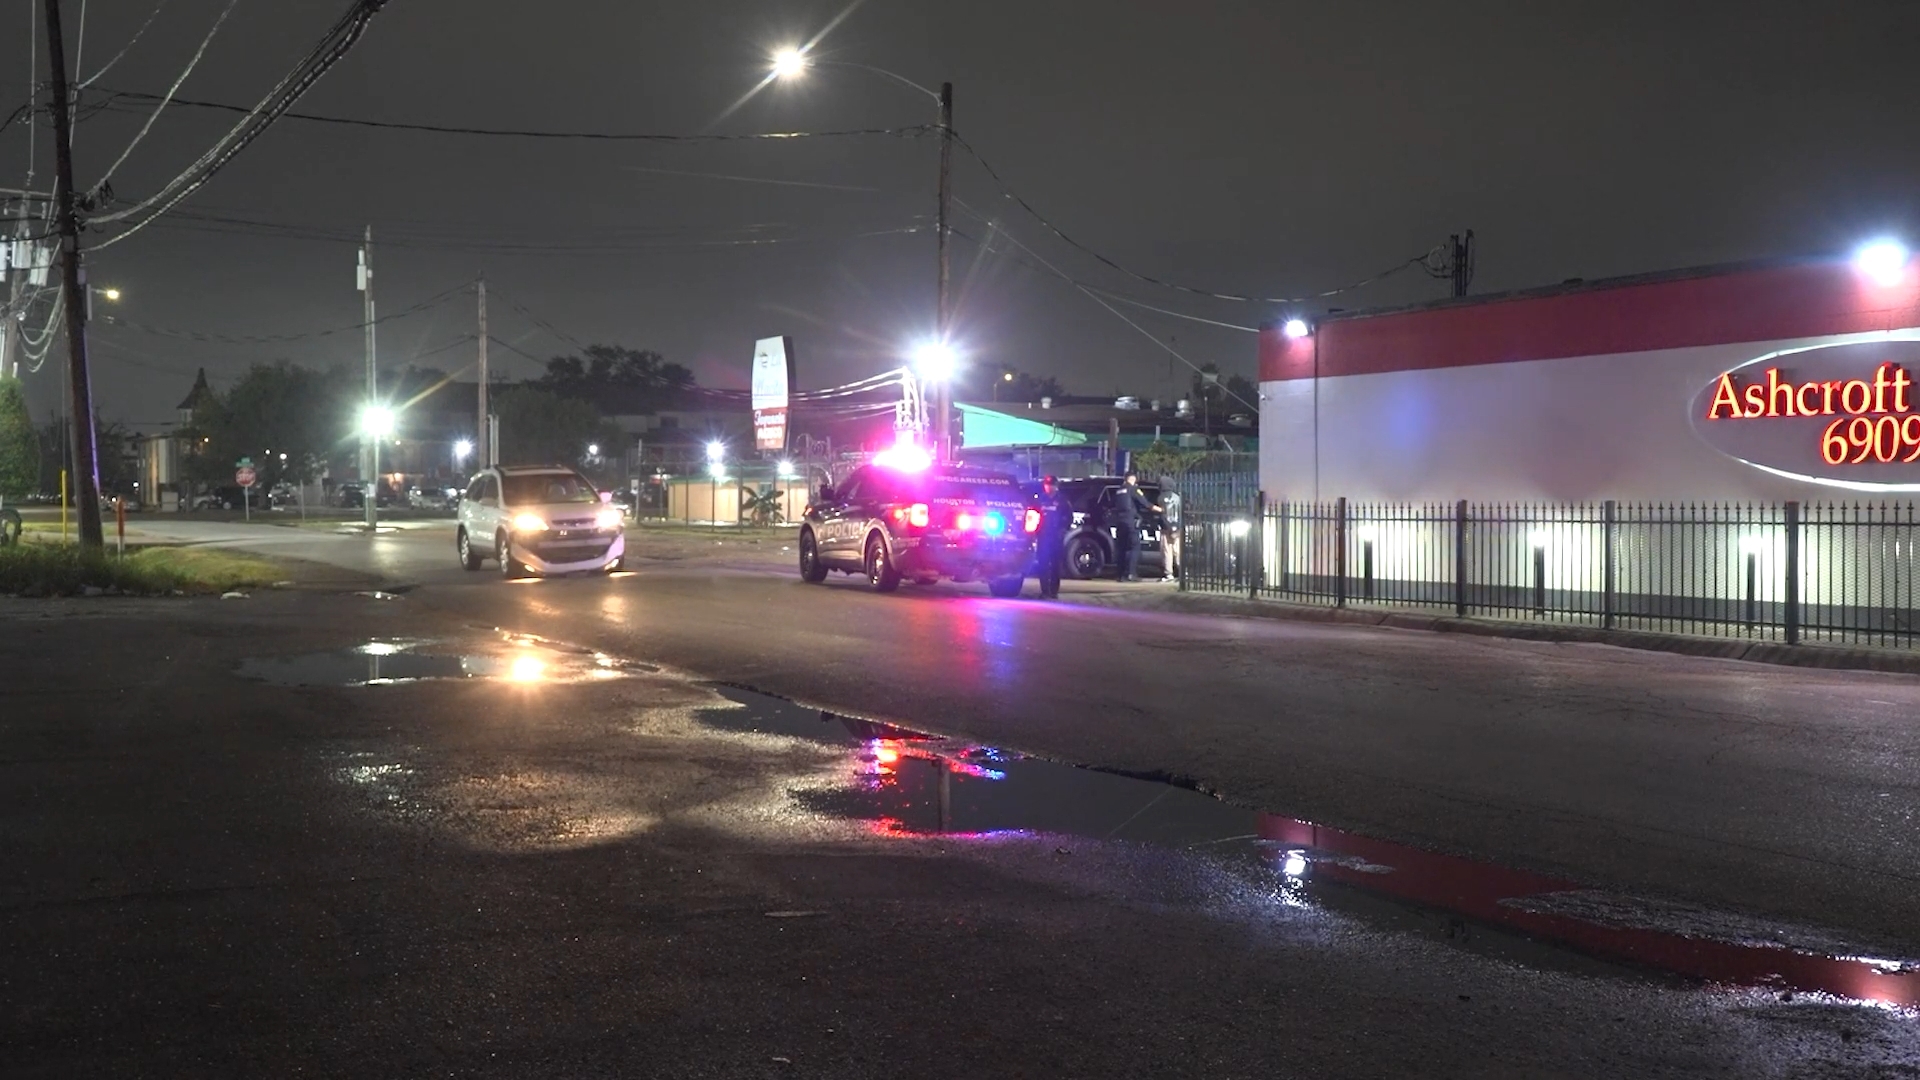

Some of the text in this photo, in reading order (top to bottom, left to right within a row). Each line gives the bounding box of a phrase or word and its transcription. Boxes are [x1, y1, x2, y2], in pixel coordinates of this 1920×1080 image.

[1706, 360, 1911, 420] Ashcroft
[1821, 413, 1920, 466] 6909
[933, 498, 1024, 508] HOUSTON POLICE
